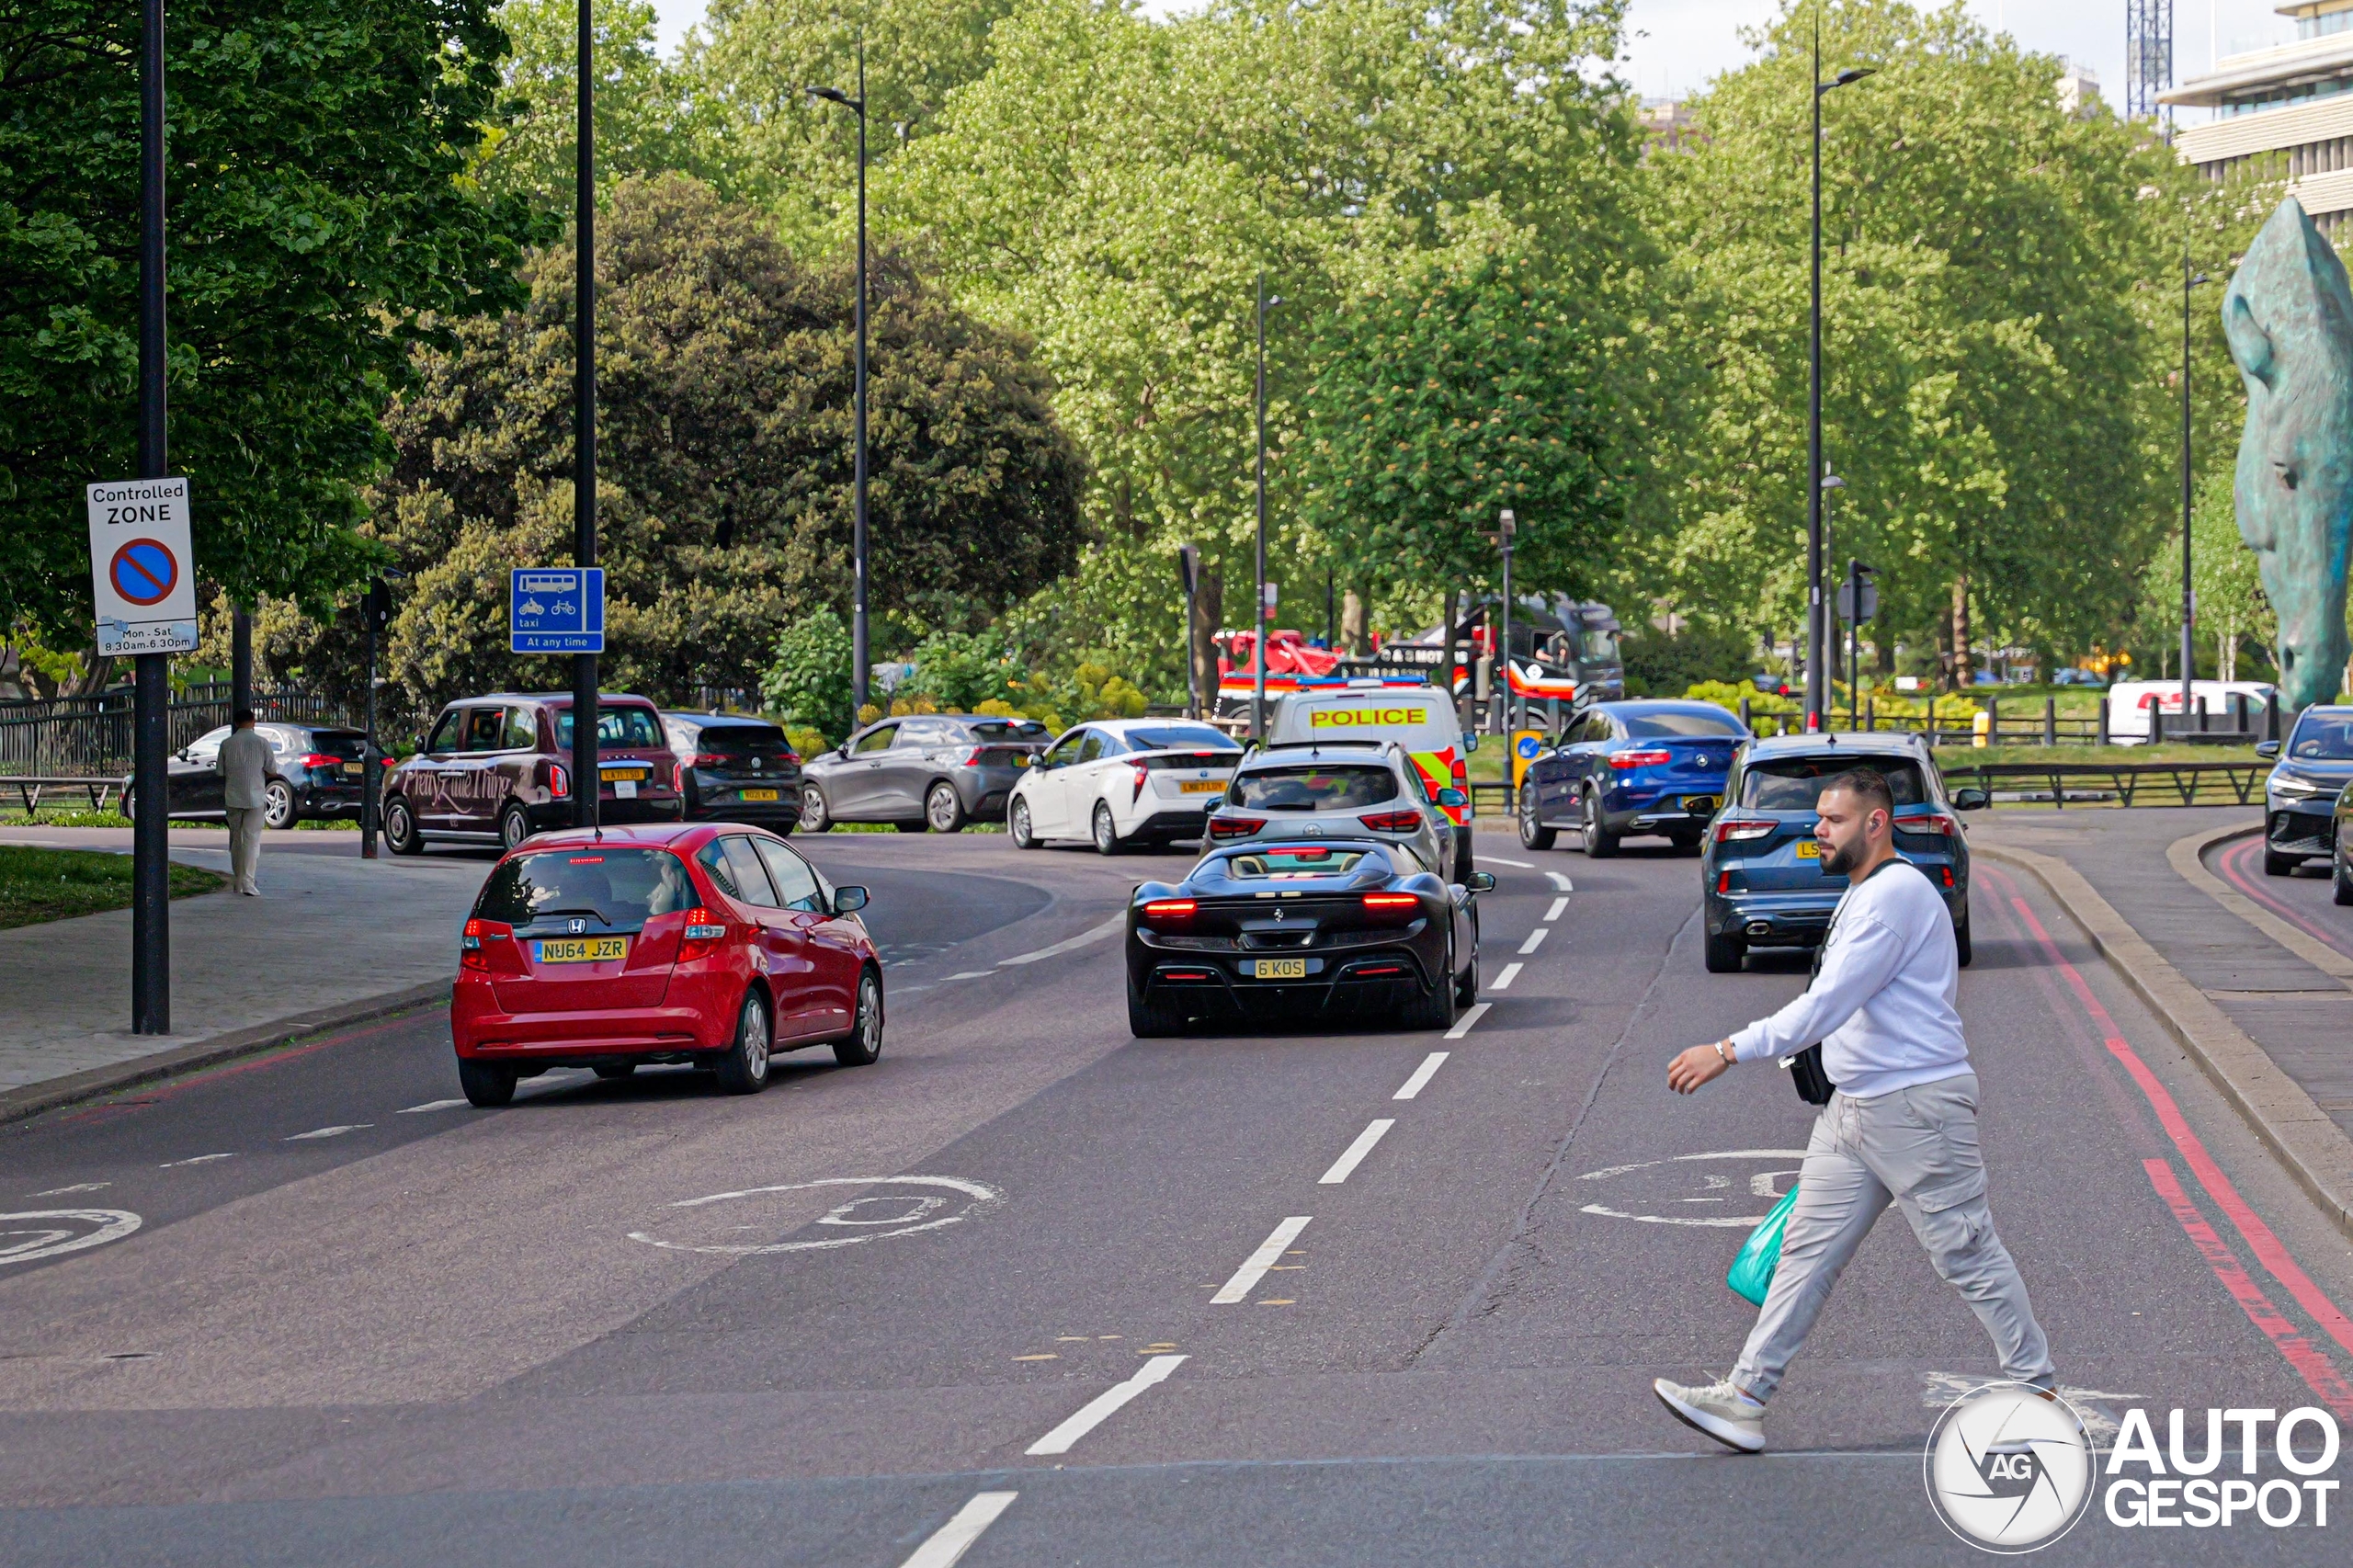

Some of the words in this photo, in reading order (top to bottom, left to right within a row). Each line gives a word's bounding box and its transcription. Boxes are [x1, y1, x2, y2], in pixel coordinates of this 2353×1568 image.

[93, 483, 184, 503] Controlled
[107, 504, 171, 525] ZONE
[519, 619, 539, 628] taxi
[122, 630, 144, 639] Mon
[154, 628, 172, 636] Sat
[527, 637, 539, 647] At
[542, 639, 561, 649] any
[564, 637, 588, 647] time
[1312, 709, 1425, 727] POLICE
[544, 943, 586, 960] NU64
[591, 941, 622, 957] JZR
[1258, 961, 1267, 975] 6
[1272, 961, 1302, 975] KOS
